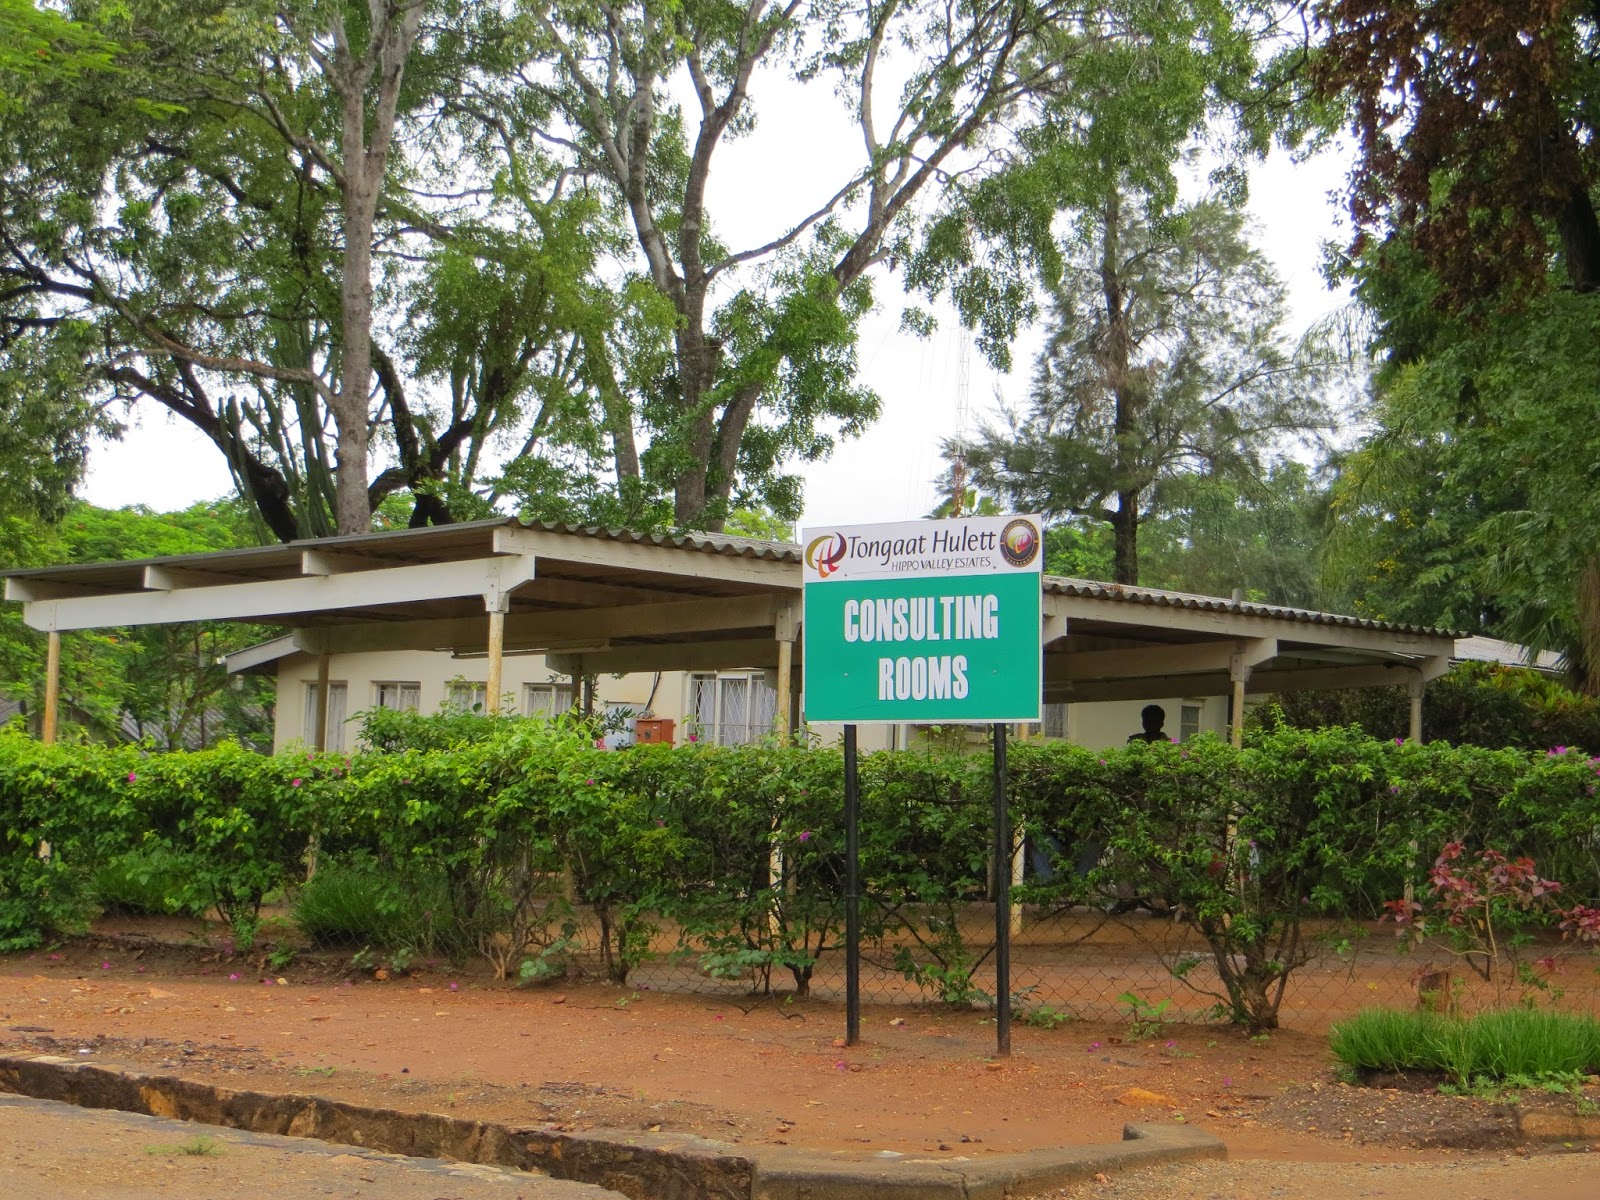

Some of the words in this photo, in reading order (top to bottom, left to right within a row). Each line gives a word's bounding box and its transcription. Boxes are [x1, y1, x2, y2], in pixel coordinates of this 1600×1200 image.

[848, 534, 926, 566] Tongaat
[932, 526, 997, 554] Hulett
[891, 560, 920, 572] HIPPO
[921, 558, 953, 571] VALLEY
[954, 556, 991, 569] ESTATES
[844, 594, 999, 643] CONSULTING
[878, 655, 969, 701] ROOMS
